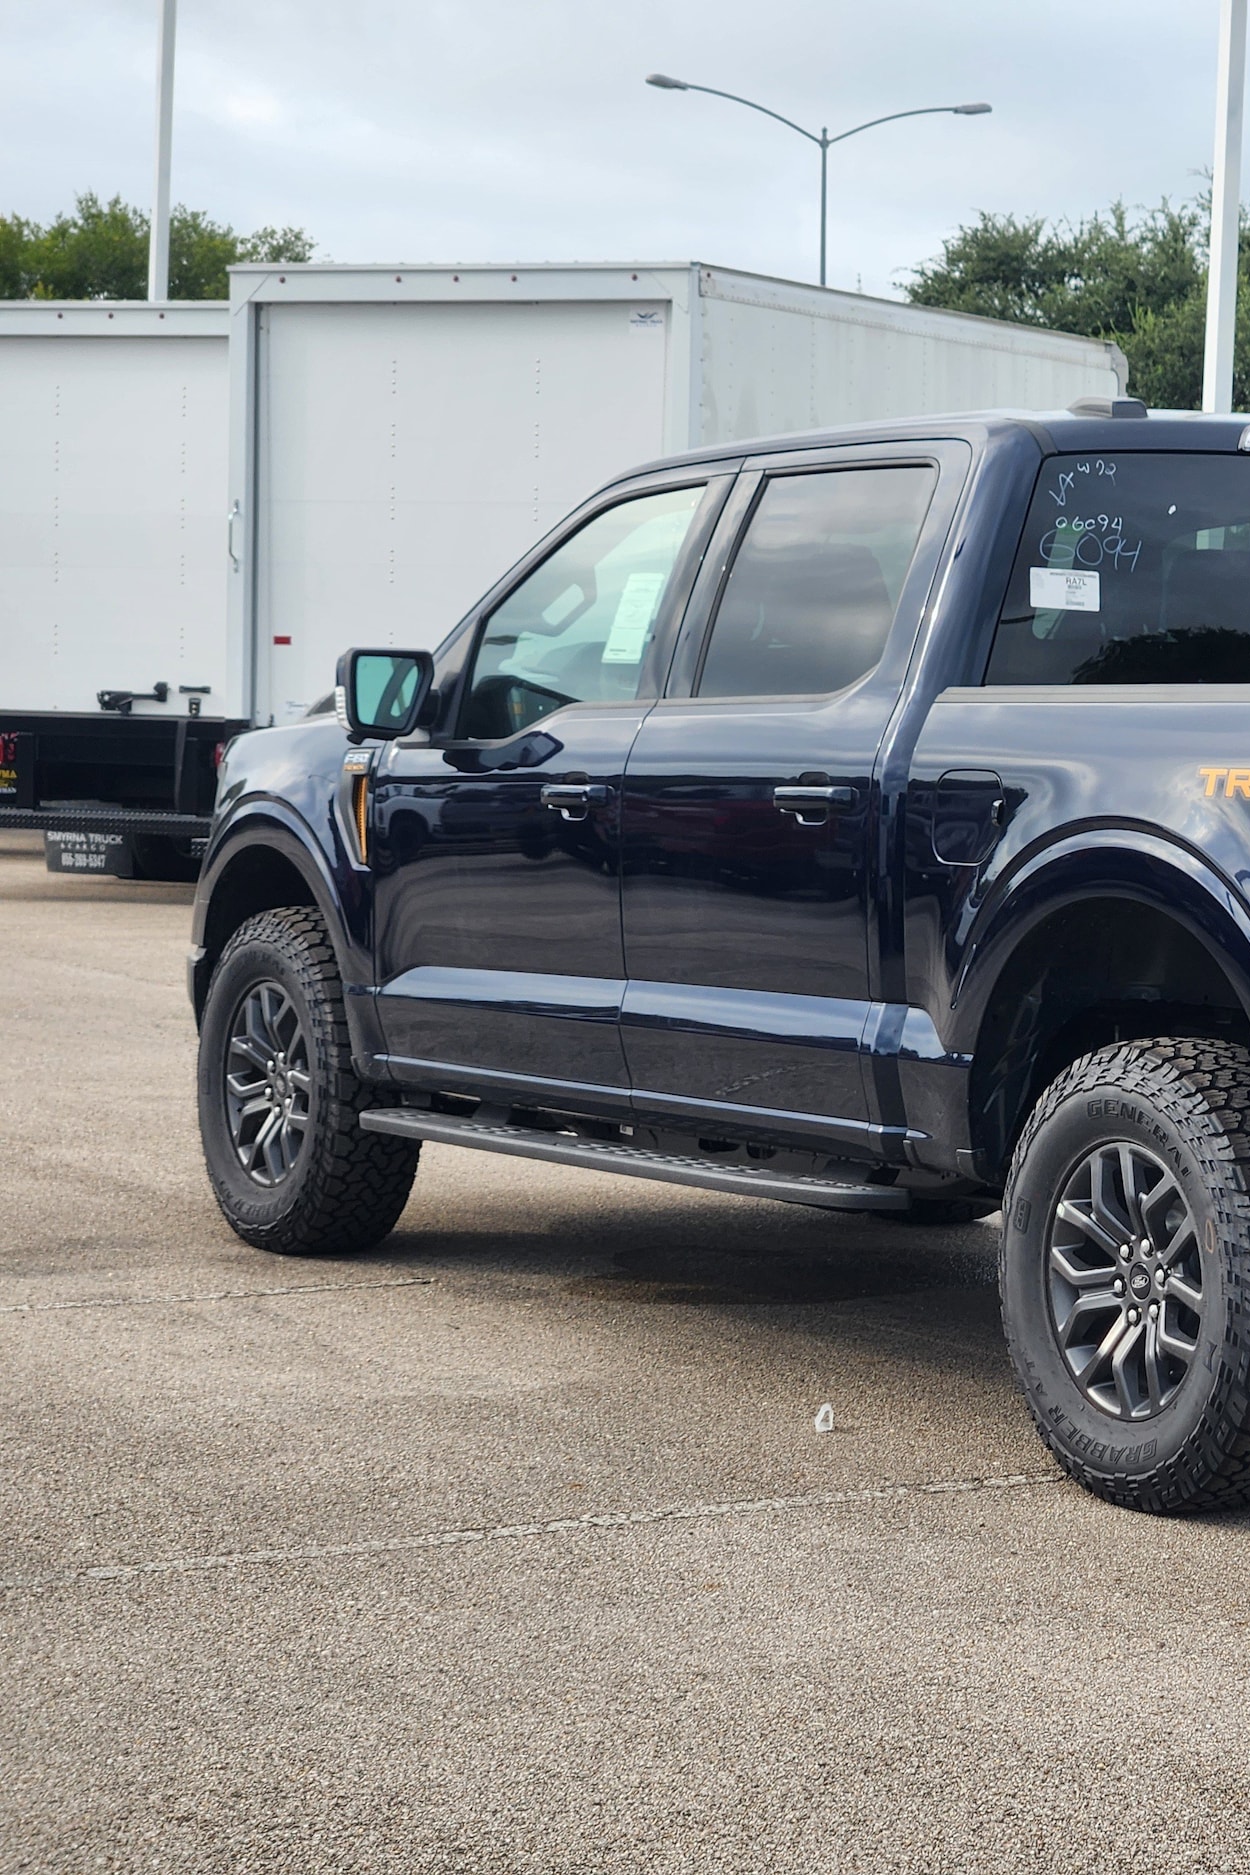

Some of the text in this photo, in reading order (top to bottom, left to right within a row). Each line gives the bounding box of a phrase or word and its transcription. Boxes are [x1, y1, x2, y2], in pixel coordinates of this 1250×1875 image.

[47, 830, 124, 845] SMYRNA TRUCK
[1047, 1405, 1158, 1465] GRABBER
